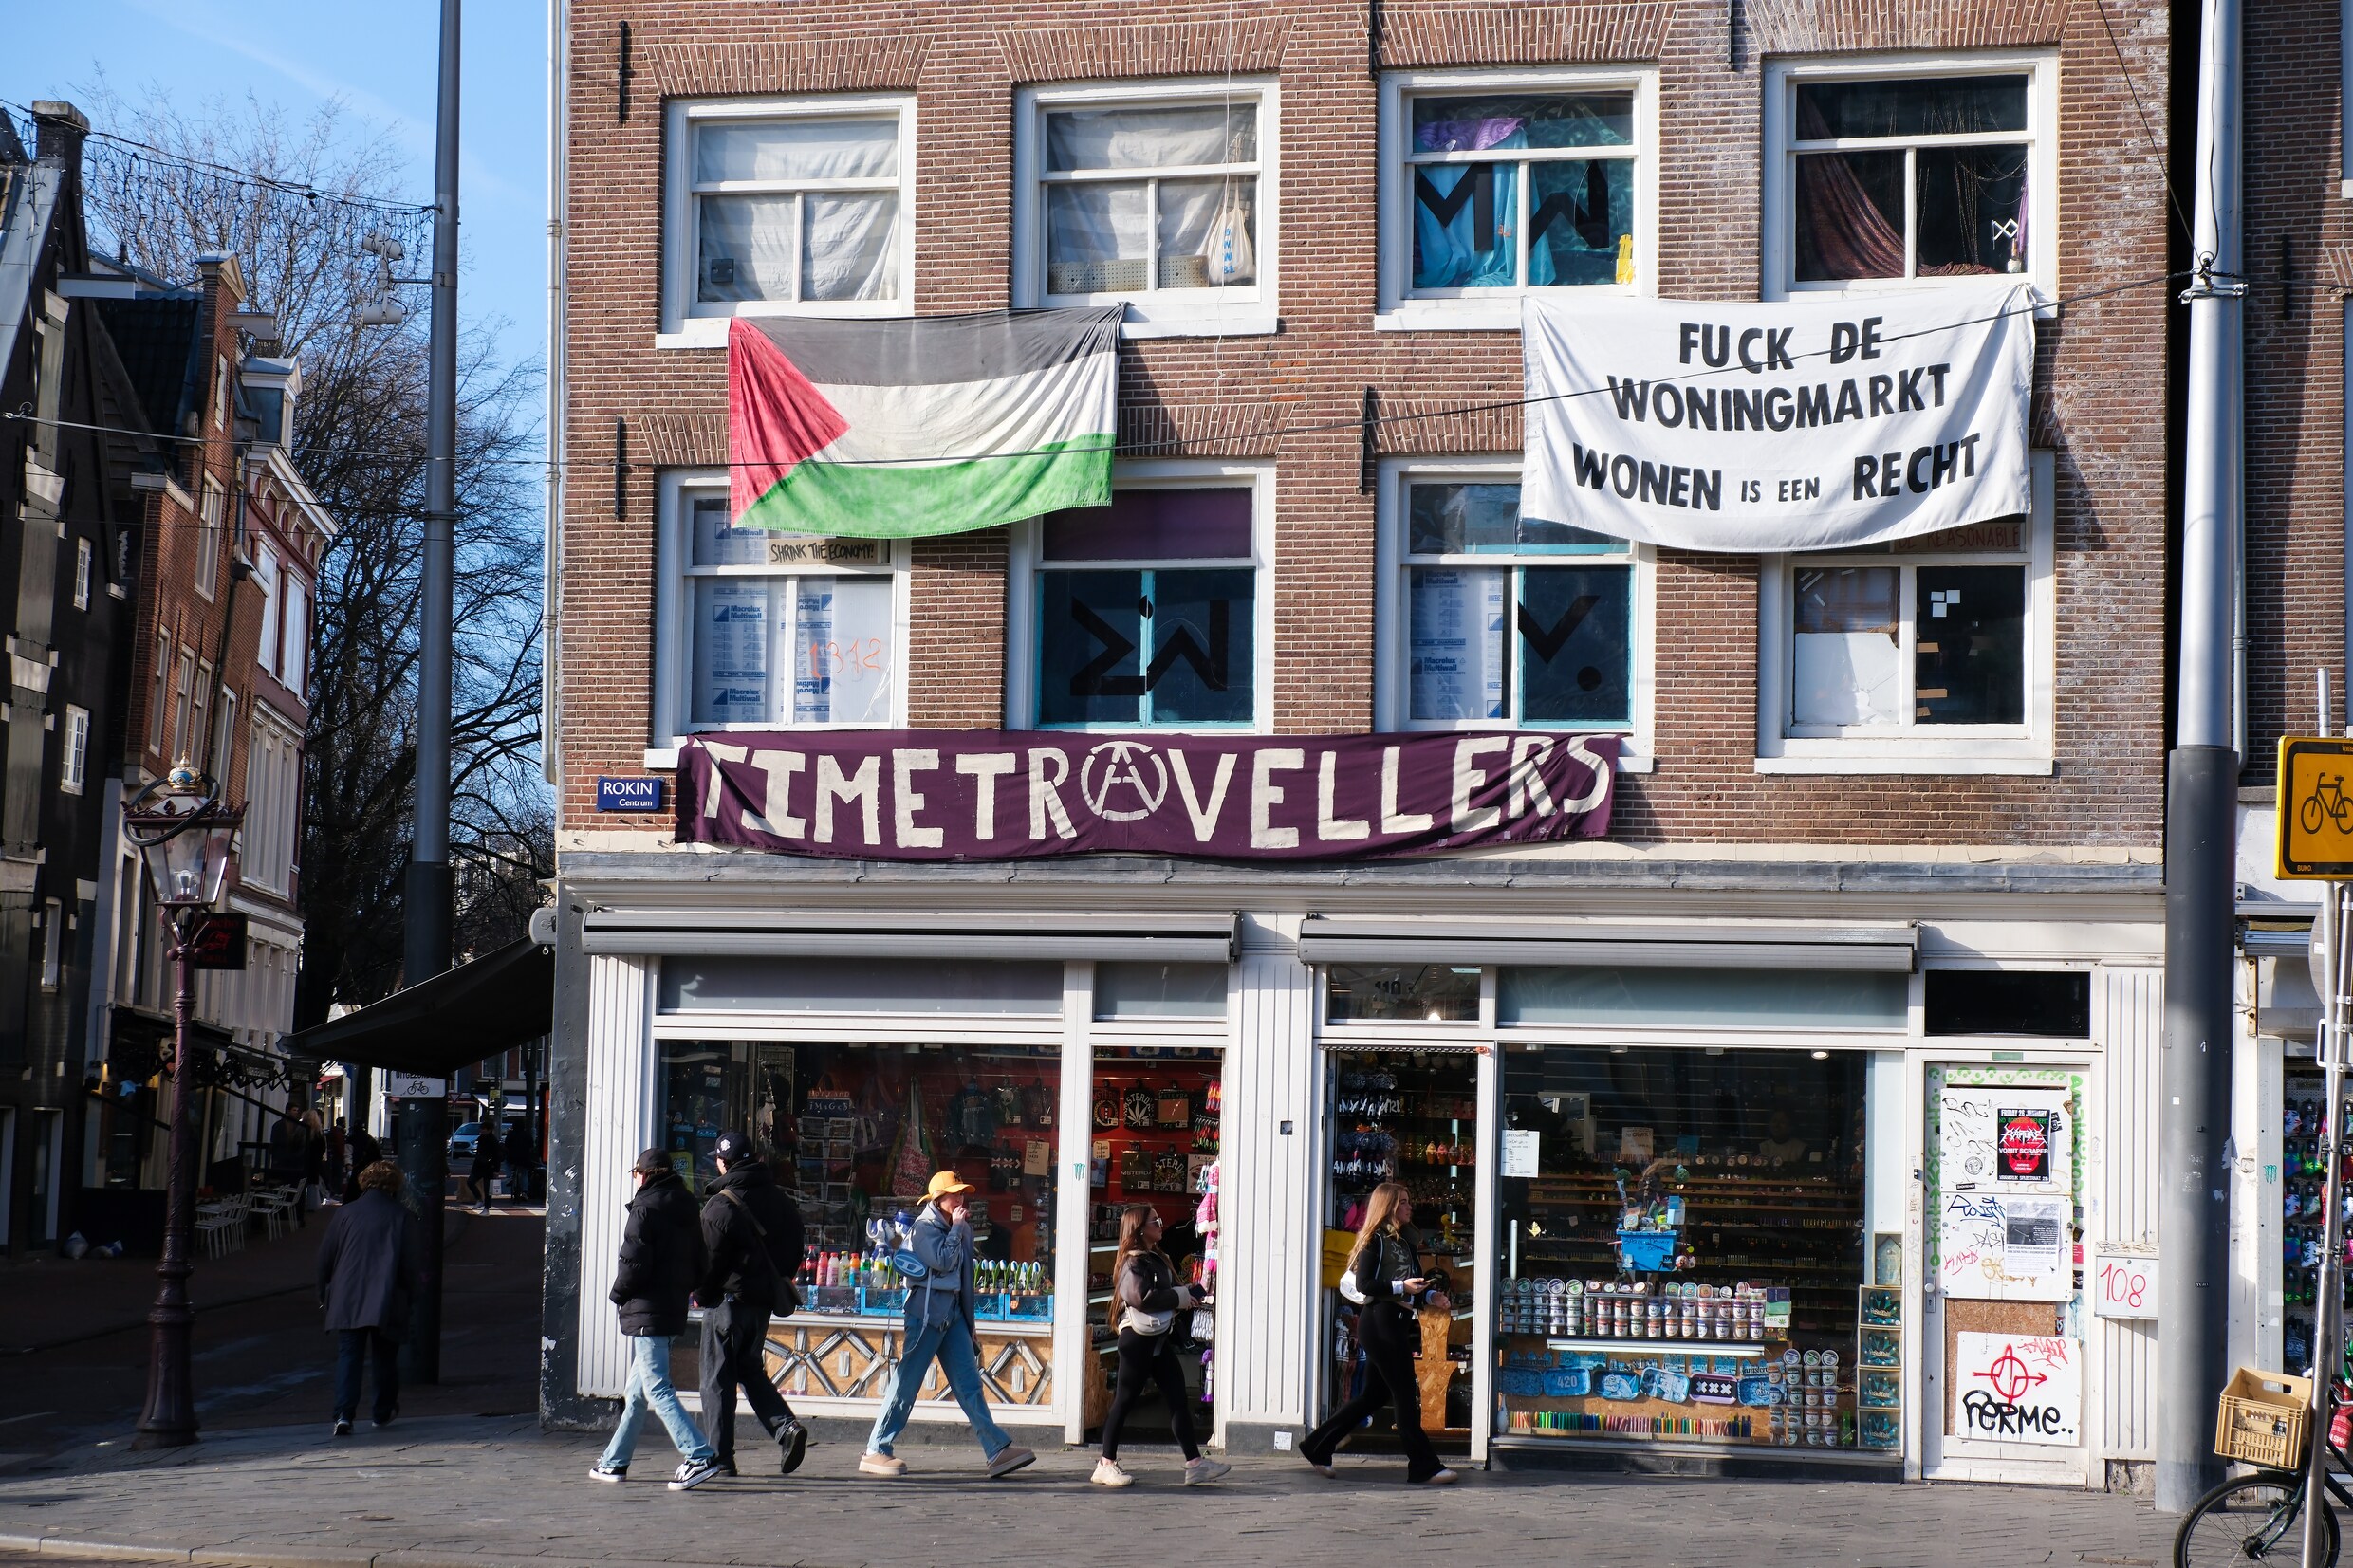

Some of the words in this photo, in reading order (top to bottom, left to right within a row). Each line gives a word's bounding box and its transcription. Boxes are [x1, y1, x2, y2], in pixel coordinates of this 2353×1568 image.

[1678, 322, 1795, 375] FUCK
[1830, 315, 1883, 366] DE
[1606, 362, 1951, 432] WONINGMARKT
[1572, 441, 1722, 511] WONEN
[1740, 479, 1762, 504] IS
[1778, 476, 1821, 504] EEN
[1852, 432, 1981, 502] RECHT
[770, 544, 807, 563] SHRINK
[807, 542, 828, 560] THE
[828, 544, 876, 561] ECONOMY!
[1927, 526, 2021, 549] REASONABLE
[809, 638, 881, 680] 1312
[602, 781, 654, 796] ROKIN
[618, 797, 654, 808] Centrum
[692, 733, 1618, 849] TIMETRAVELLERS
[2100, 1263, 2146, 1308] 108
[1556, 1375, 1578, 1388] 420
